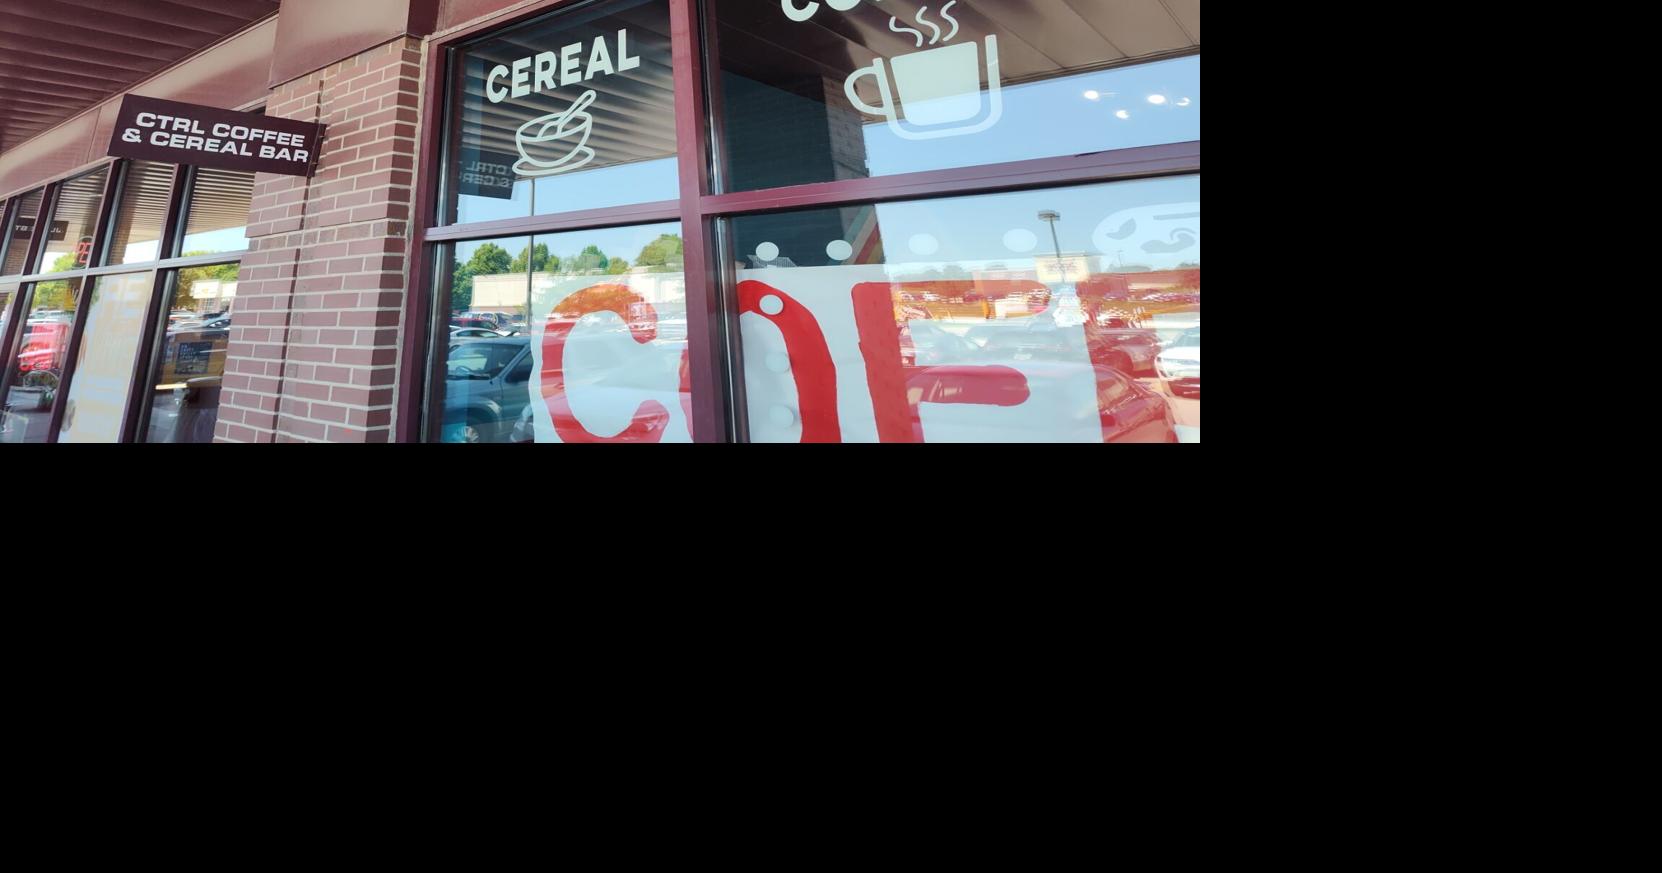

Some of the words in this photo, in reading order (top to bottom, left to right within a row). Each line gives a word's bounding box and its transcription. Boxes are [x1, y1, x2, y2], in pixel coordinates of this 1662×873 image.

[486, 28, 640, 104] CEREAL
[122, 128, 142, 143] &
[150, 131, 253, 157] CEREAL
[259, 145, 309, 163] BAR
[136, 112, 205, 135] CTRL
[212, 123, 305, 148] COFFEE
